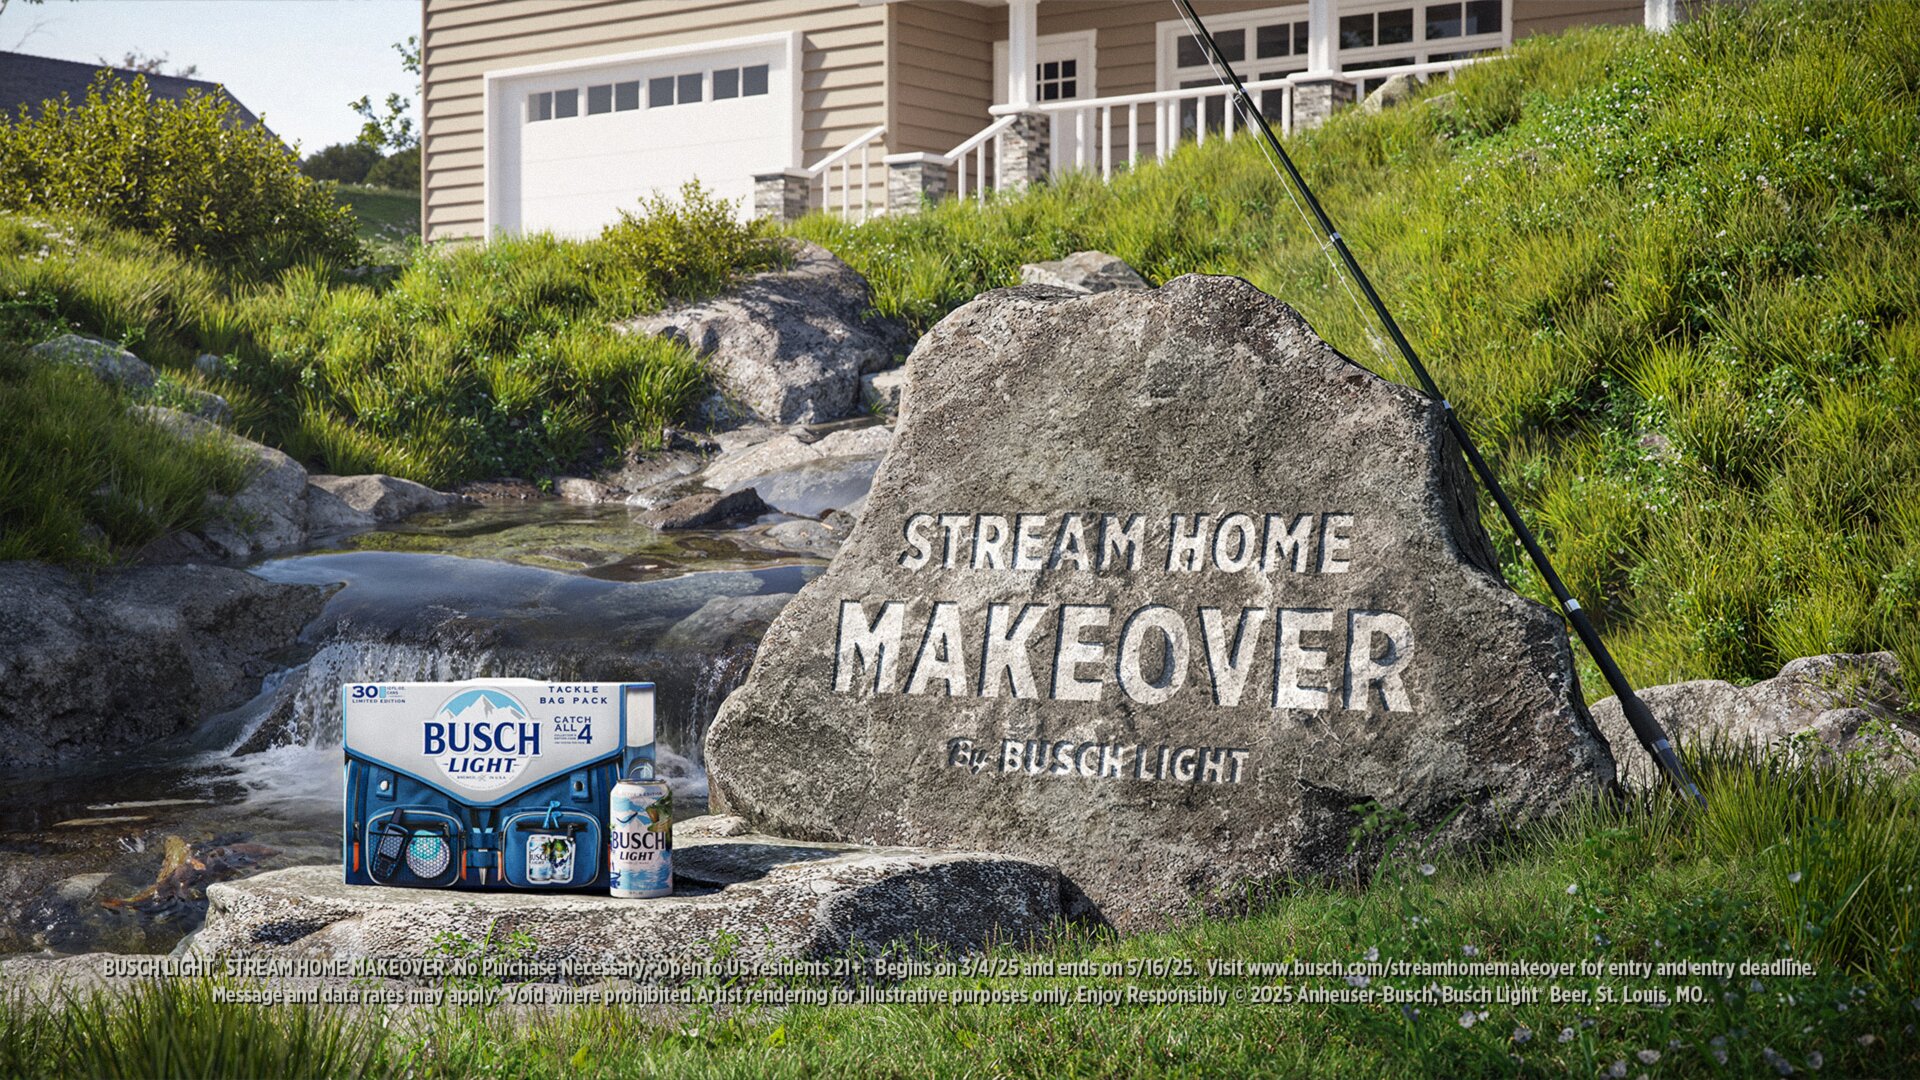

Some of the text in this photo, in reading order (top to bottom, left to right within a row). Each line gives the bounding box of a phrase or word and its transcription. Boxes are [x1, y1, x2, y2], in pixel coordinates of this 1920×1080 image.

[899, 511, 1354, 573] STREAM HOME
[831, 599, 1416, 713] MAKEOVER
[352, 685, 378, 698] 30
[424, 722, 541, 755] BUSCH
[554, 724, 577, 732] ALL
[578, 724, 593, 744] 4
[448, 757, 516, 773] LIGHT
[947, 736, 1250, 784] By BUSCH LIGHT
[612, 831, 666, 850] BUSCH
[620, 851, 655, 861] LIGHT
